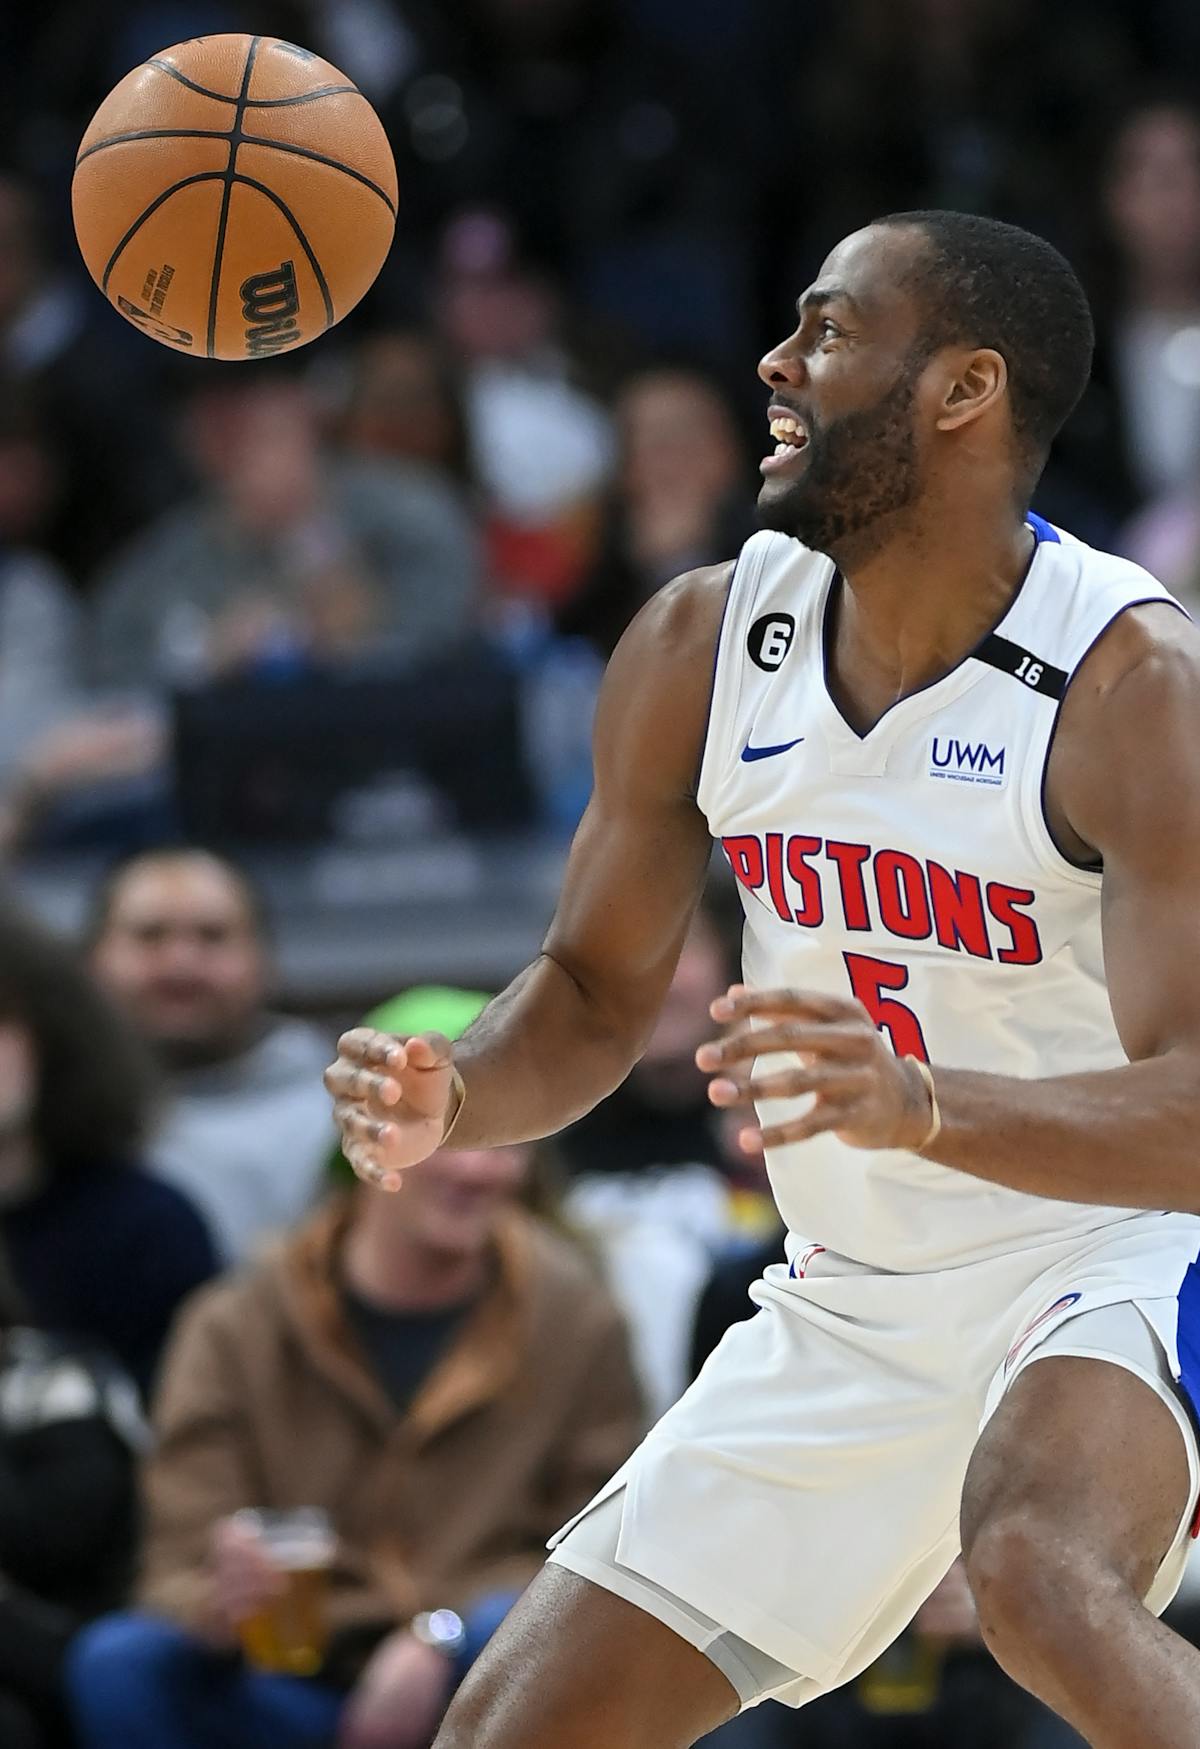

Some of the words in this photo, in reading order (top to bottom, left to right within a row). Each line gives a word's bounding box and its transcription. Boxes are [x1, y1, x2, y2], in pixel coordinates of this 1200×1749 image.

[759, 621, 792, 665] 6
[1014, 656, 1044, 686] 16
[932, 737, 1005, 775] UWM
[721, 832, 1044, 966] PISTONS
[842, 951, 931, 1065] 5
